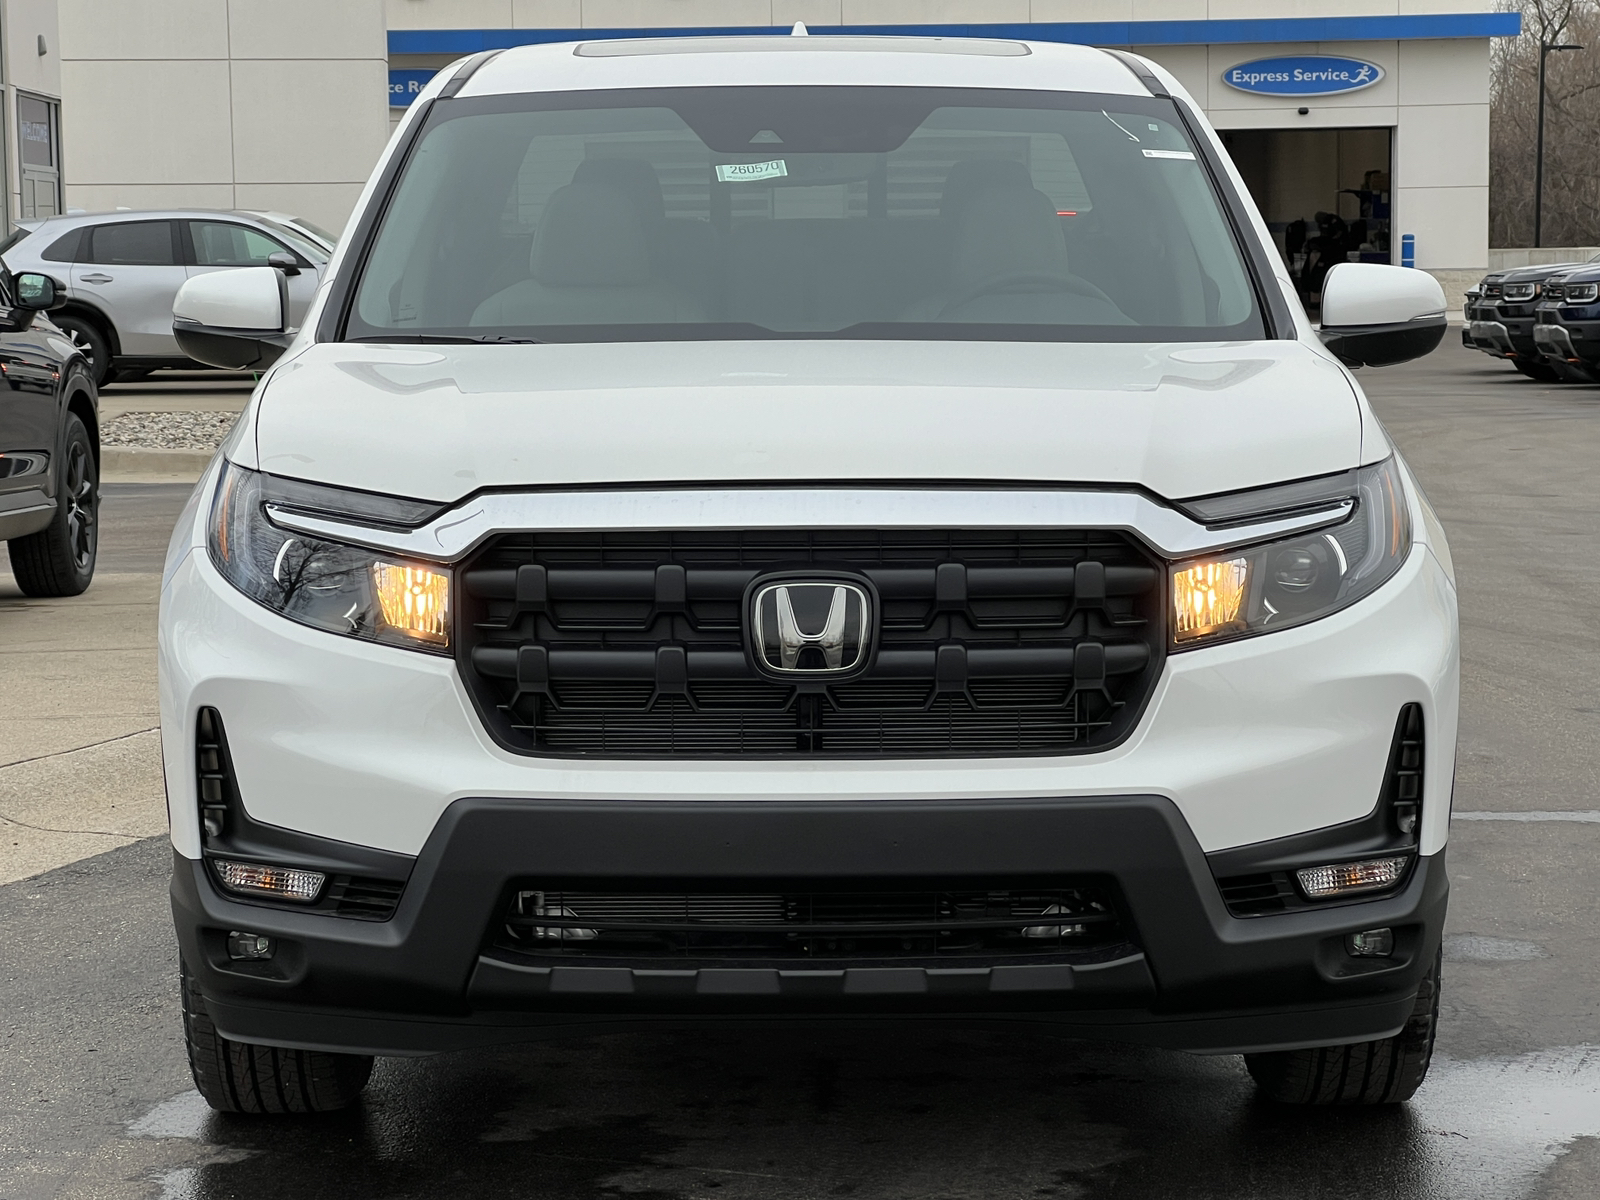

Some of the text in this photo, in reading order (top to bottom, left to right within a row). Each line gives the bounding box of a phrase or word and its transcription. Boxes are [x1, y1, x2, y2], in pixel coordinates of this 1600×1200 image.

[1232, 69, 1349, 85] Express Service
[729, 162, 779, 174] 260570
